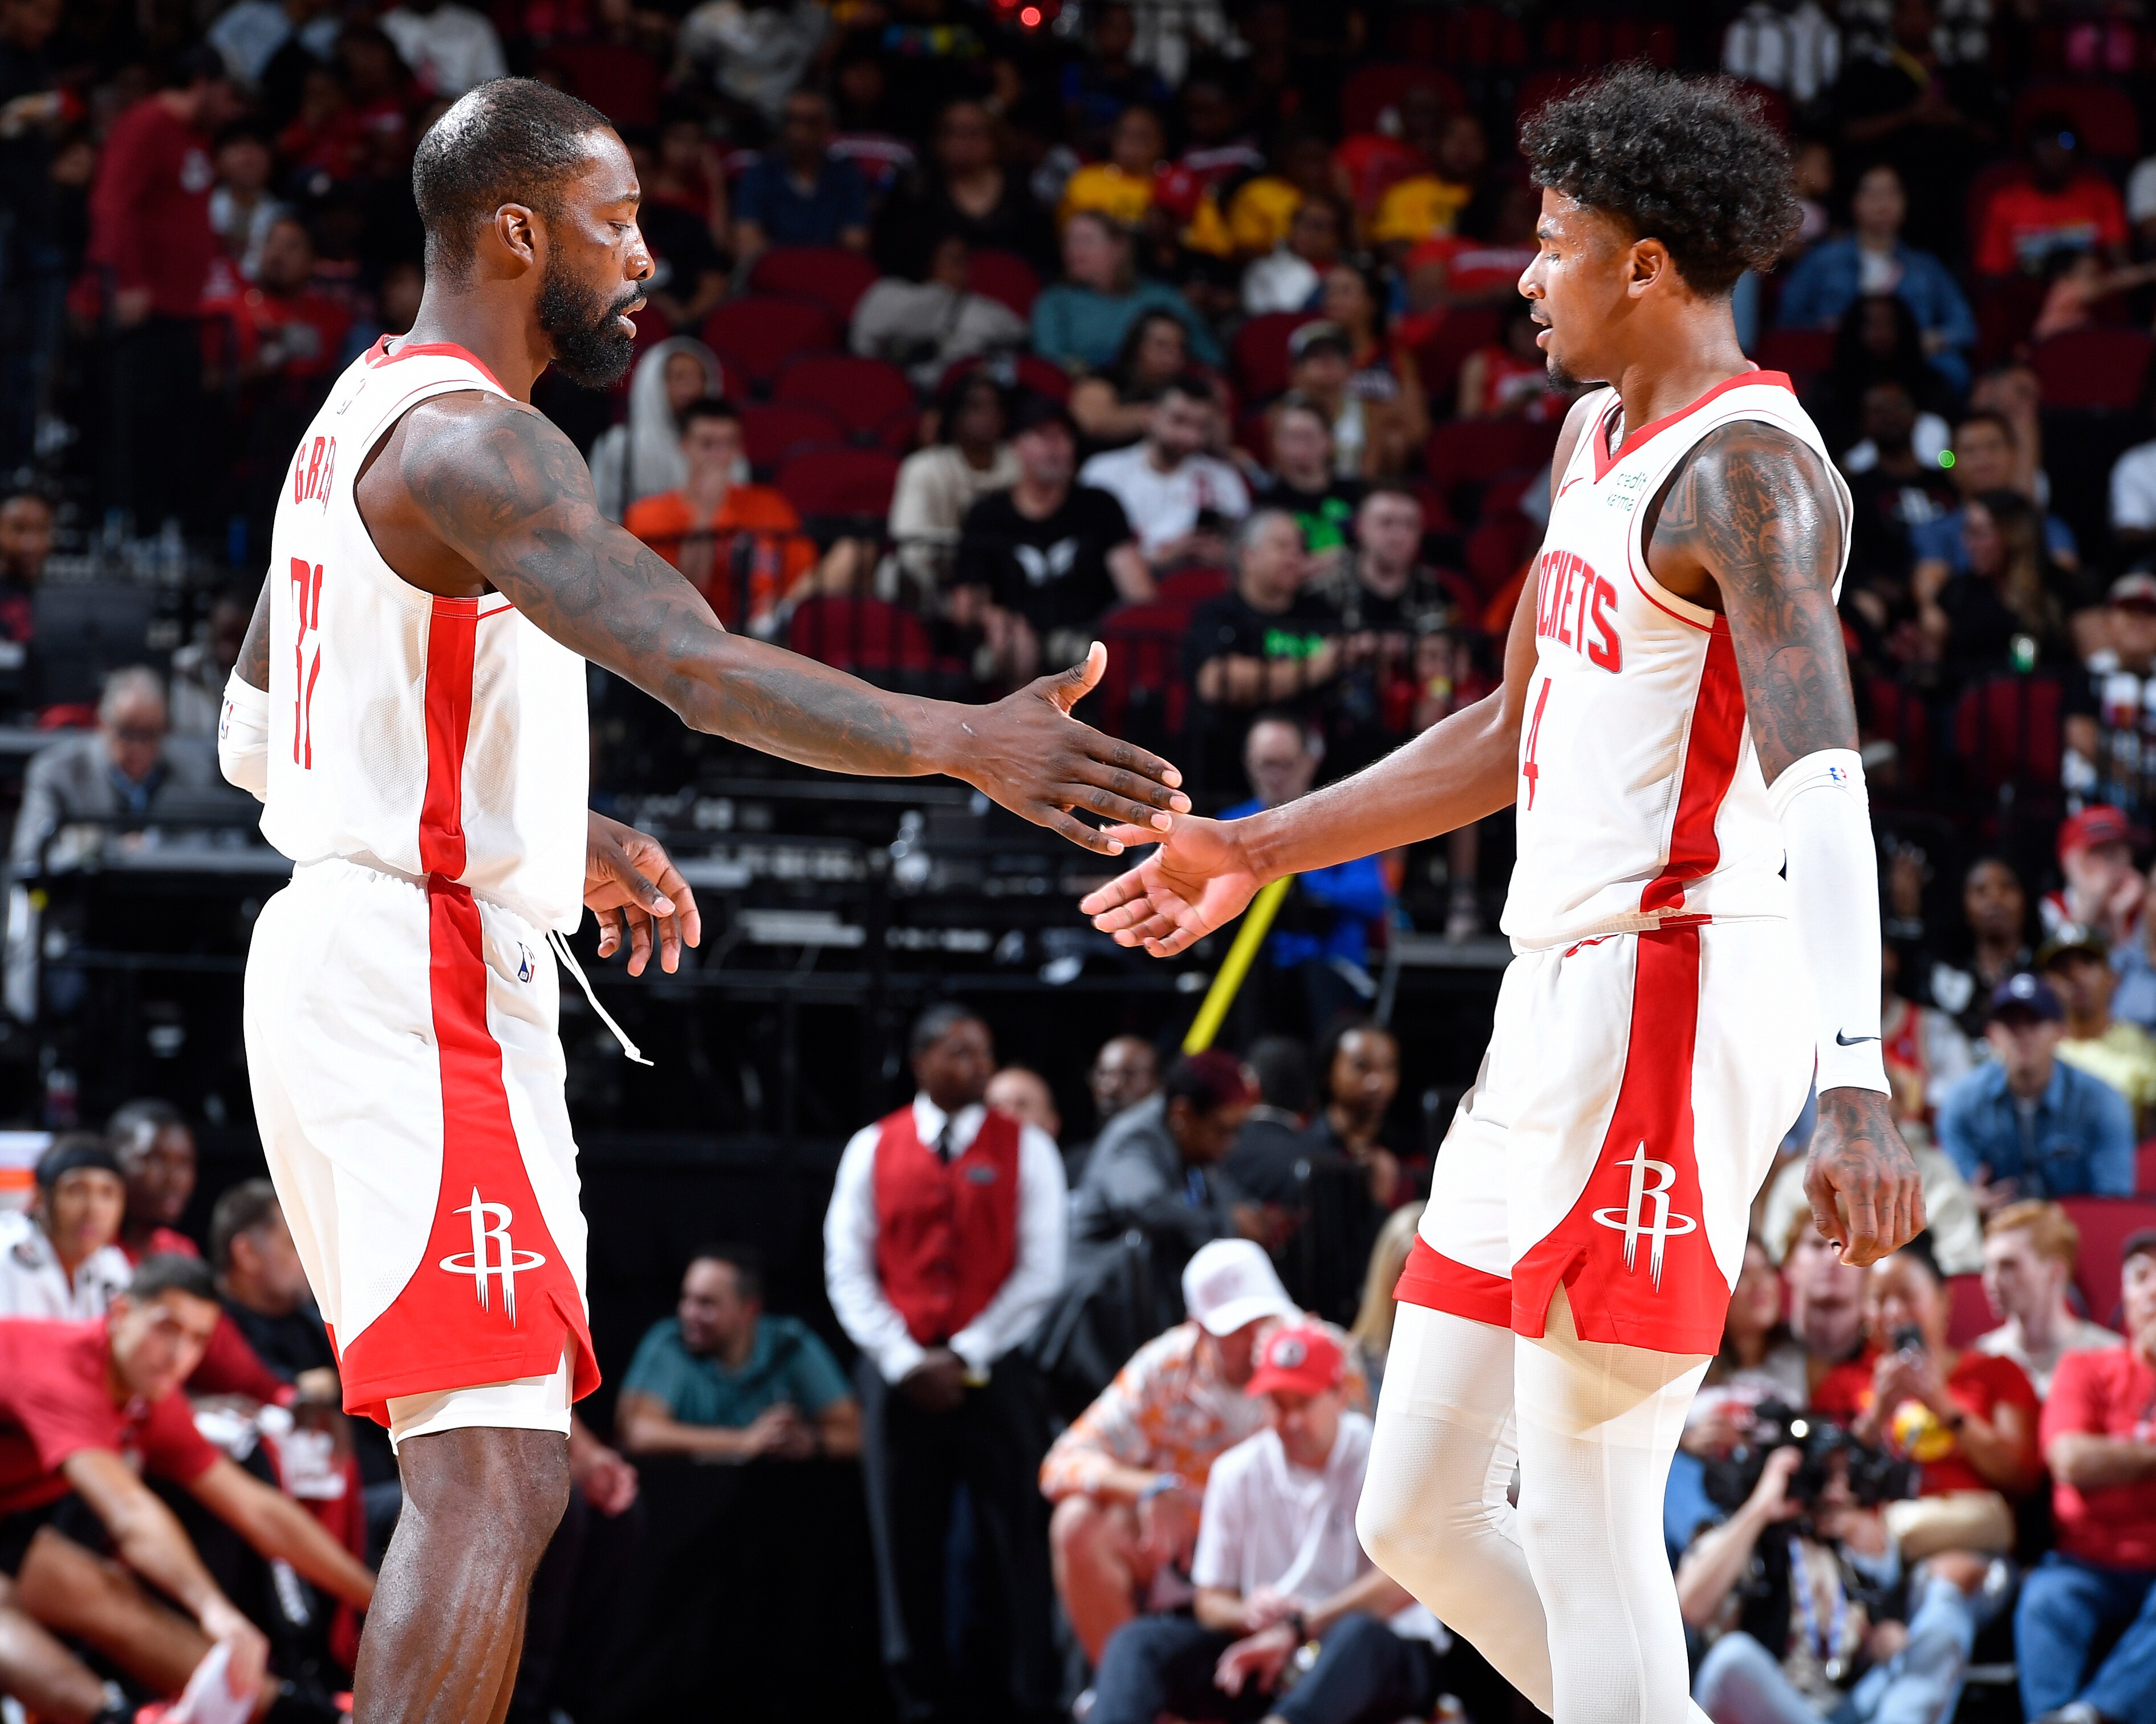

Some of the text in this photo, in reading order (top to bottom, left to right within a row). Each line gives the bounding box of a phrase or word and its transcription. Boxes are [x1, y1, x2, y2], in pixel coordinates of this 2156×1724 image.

[1606, 489, 1634, 511] karma
[1617, 472, 1647, 491] credit
[1538, 549, 1623, 674] OCKETS
[1523, 677, 1552, 811] 4
